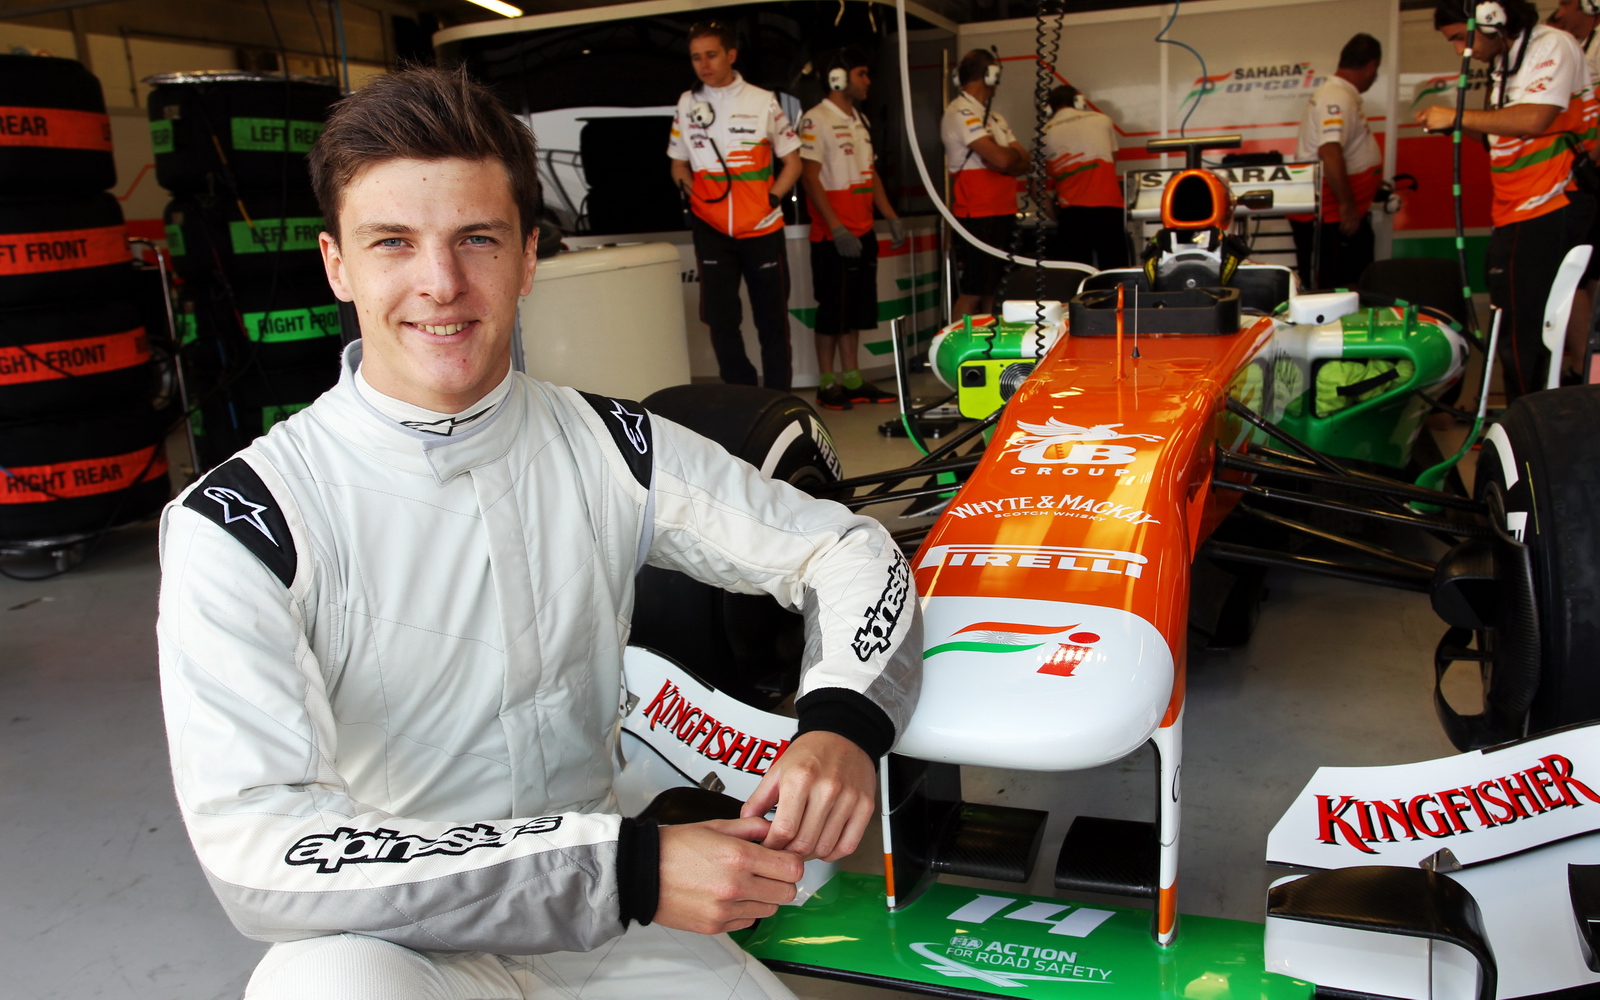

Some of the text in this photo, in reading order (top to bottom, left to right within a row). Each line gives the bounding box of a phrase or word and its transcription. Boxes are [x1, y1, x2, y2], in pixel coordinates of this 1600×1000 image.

[1234, 64, 1302, 80] SAHARA
[250, 125, 289, 142] LEFT
[251, 224, 326, 244] LEFT FRO
[26, 238, 88, 262] FRONT
[257, 311, 338, 335] RIGHT FRO
[46, 344, 107, 369] FRONT
[6, 464, 124, 494] RIGHT REAR
[1009, 467, 1131, 478] GROUP
[947, 494, 1161, 525] WHYTE & MACKAY
[993, 510, 1107, 522] SCOTCH WHISKY
[918, 544, 1149, 579] PIRELLI
[1313, 753, 1600, 854] KINGFISHER
[946, 894, 1117, 938] 14
[951, 937, 1078, 964] FIA ACTION
[946, 947, 1113, 981] FOR ROAD SAFETY
